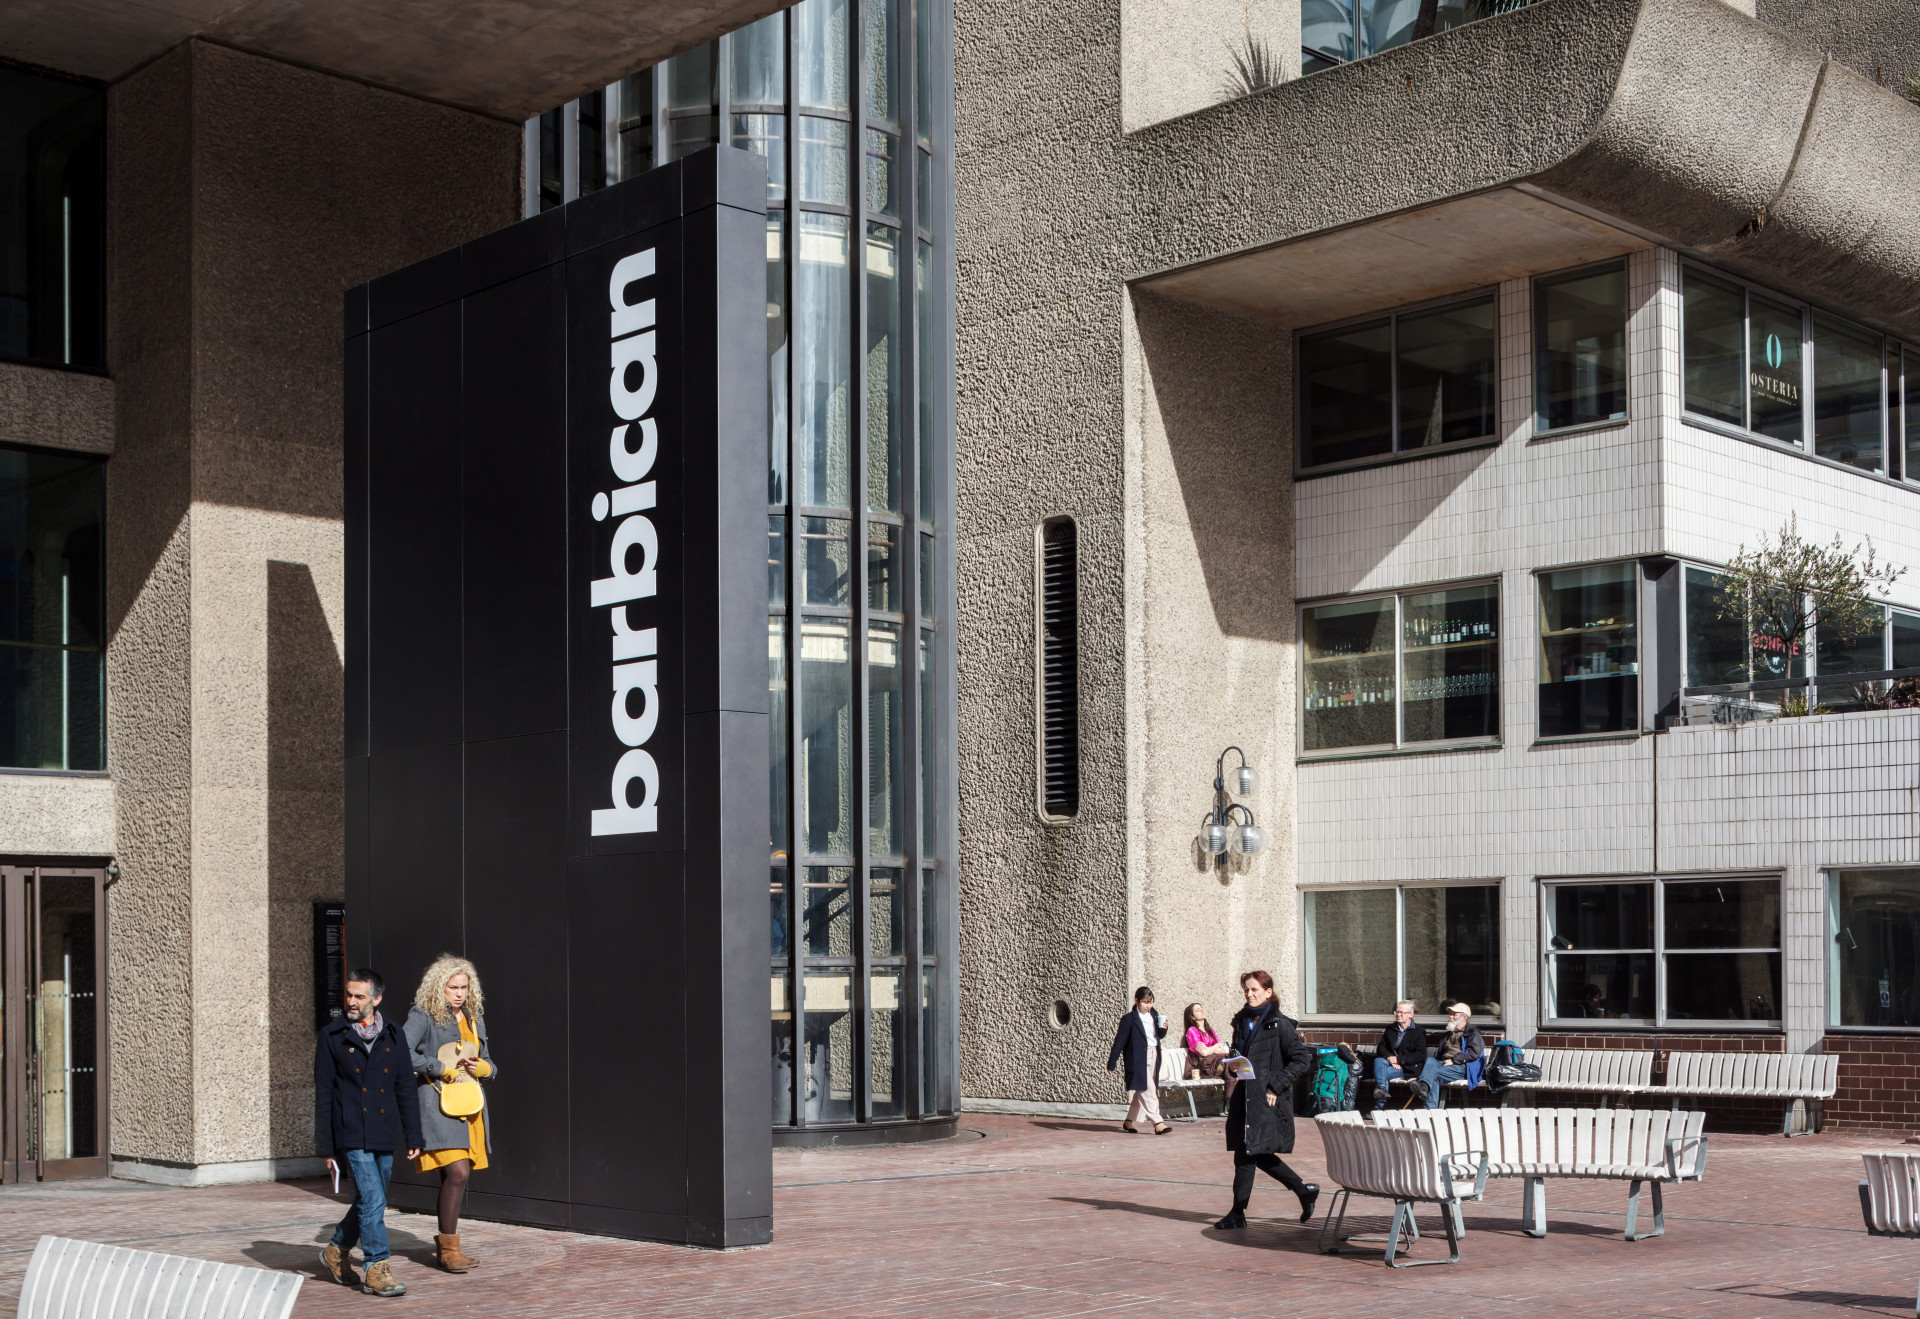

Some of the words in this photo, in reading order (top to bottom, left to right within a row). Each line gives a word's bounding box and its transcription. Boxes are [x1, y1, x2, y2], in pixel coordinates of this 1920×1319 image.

[1751, 372, 1798, 400] OSTERIA
[591, 247, 659, 836] barbican
[1752, 632, 1799, 656] BONFIE
